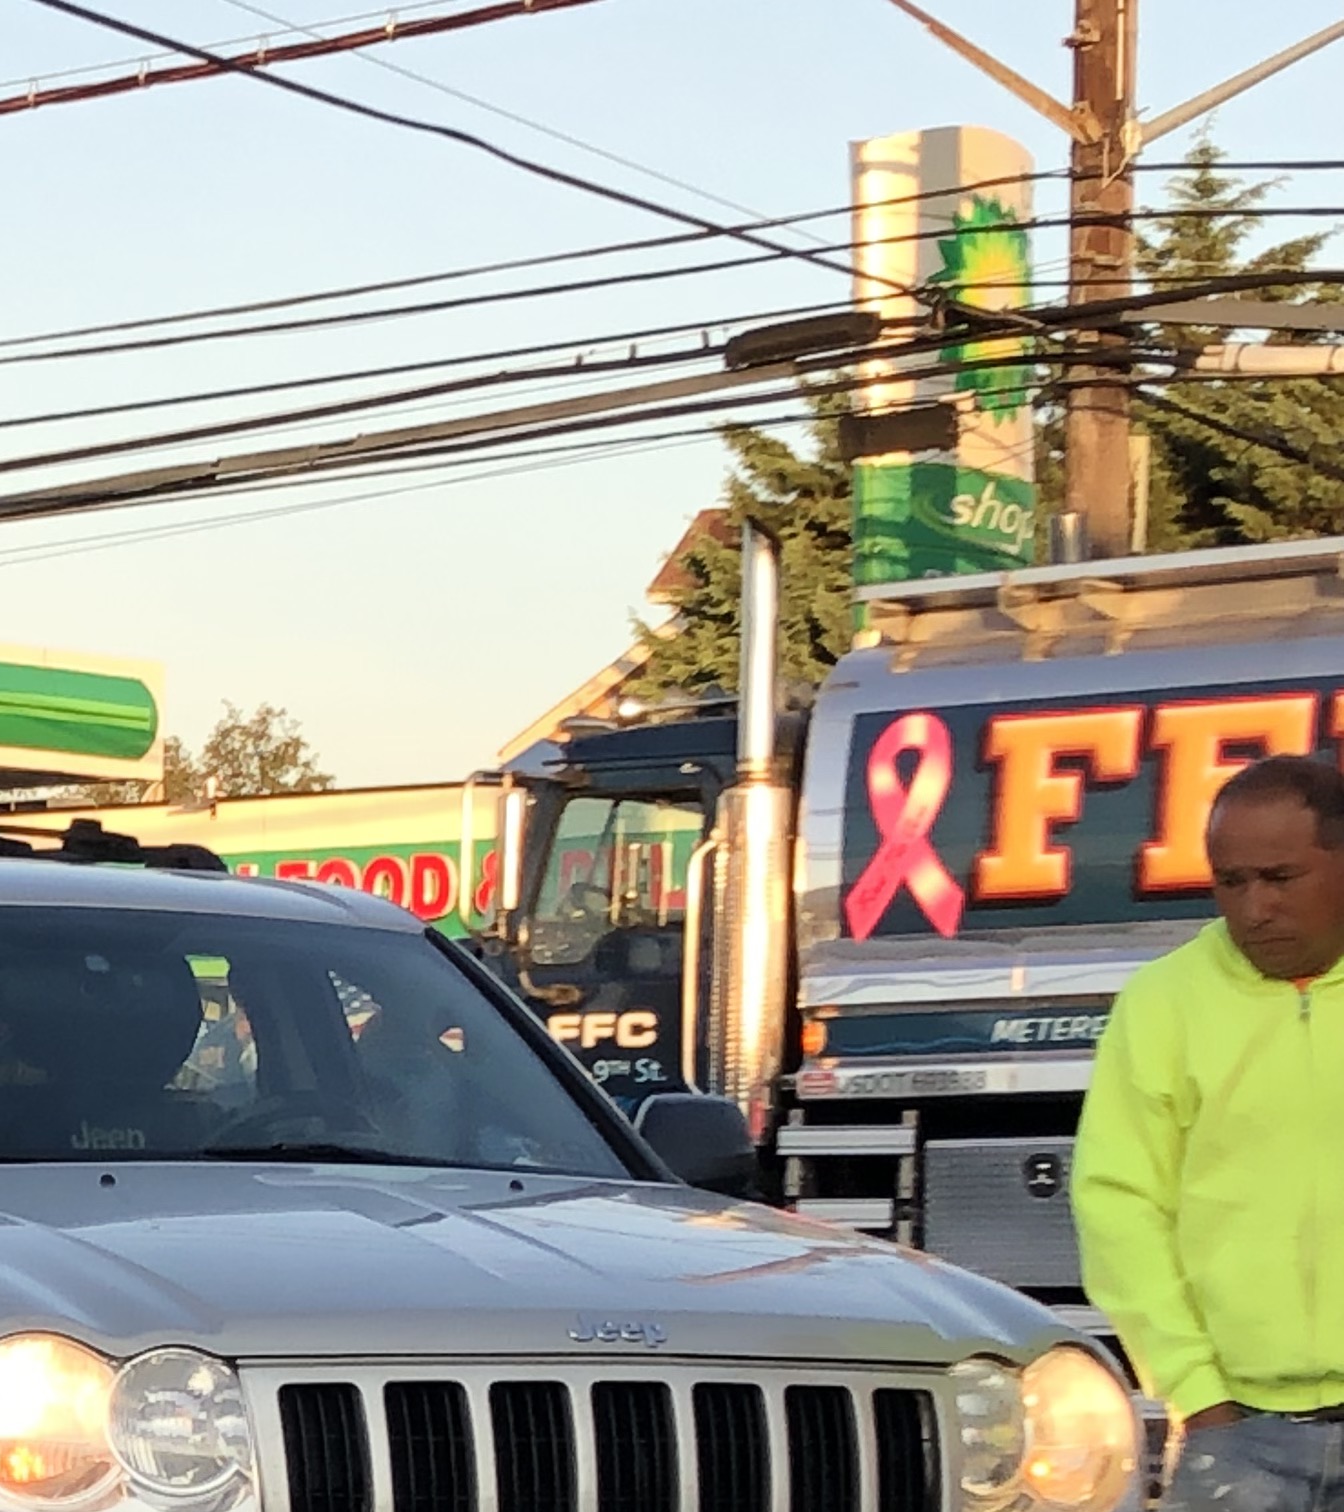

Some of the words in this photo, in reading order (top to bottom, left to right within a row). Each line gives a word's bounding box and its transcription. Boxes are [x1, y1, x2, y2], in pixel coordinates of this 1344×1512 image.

[277, 853, 458, 921] OOD
[547, 1011, 659, 1050] FFC
[568, 1311, 668, 1349] Jeep
